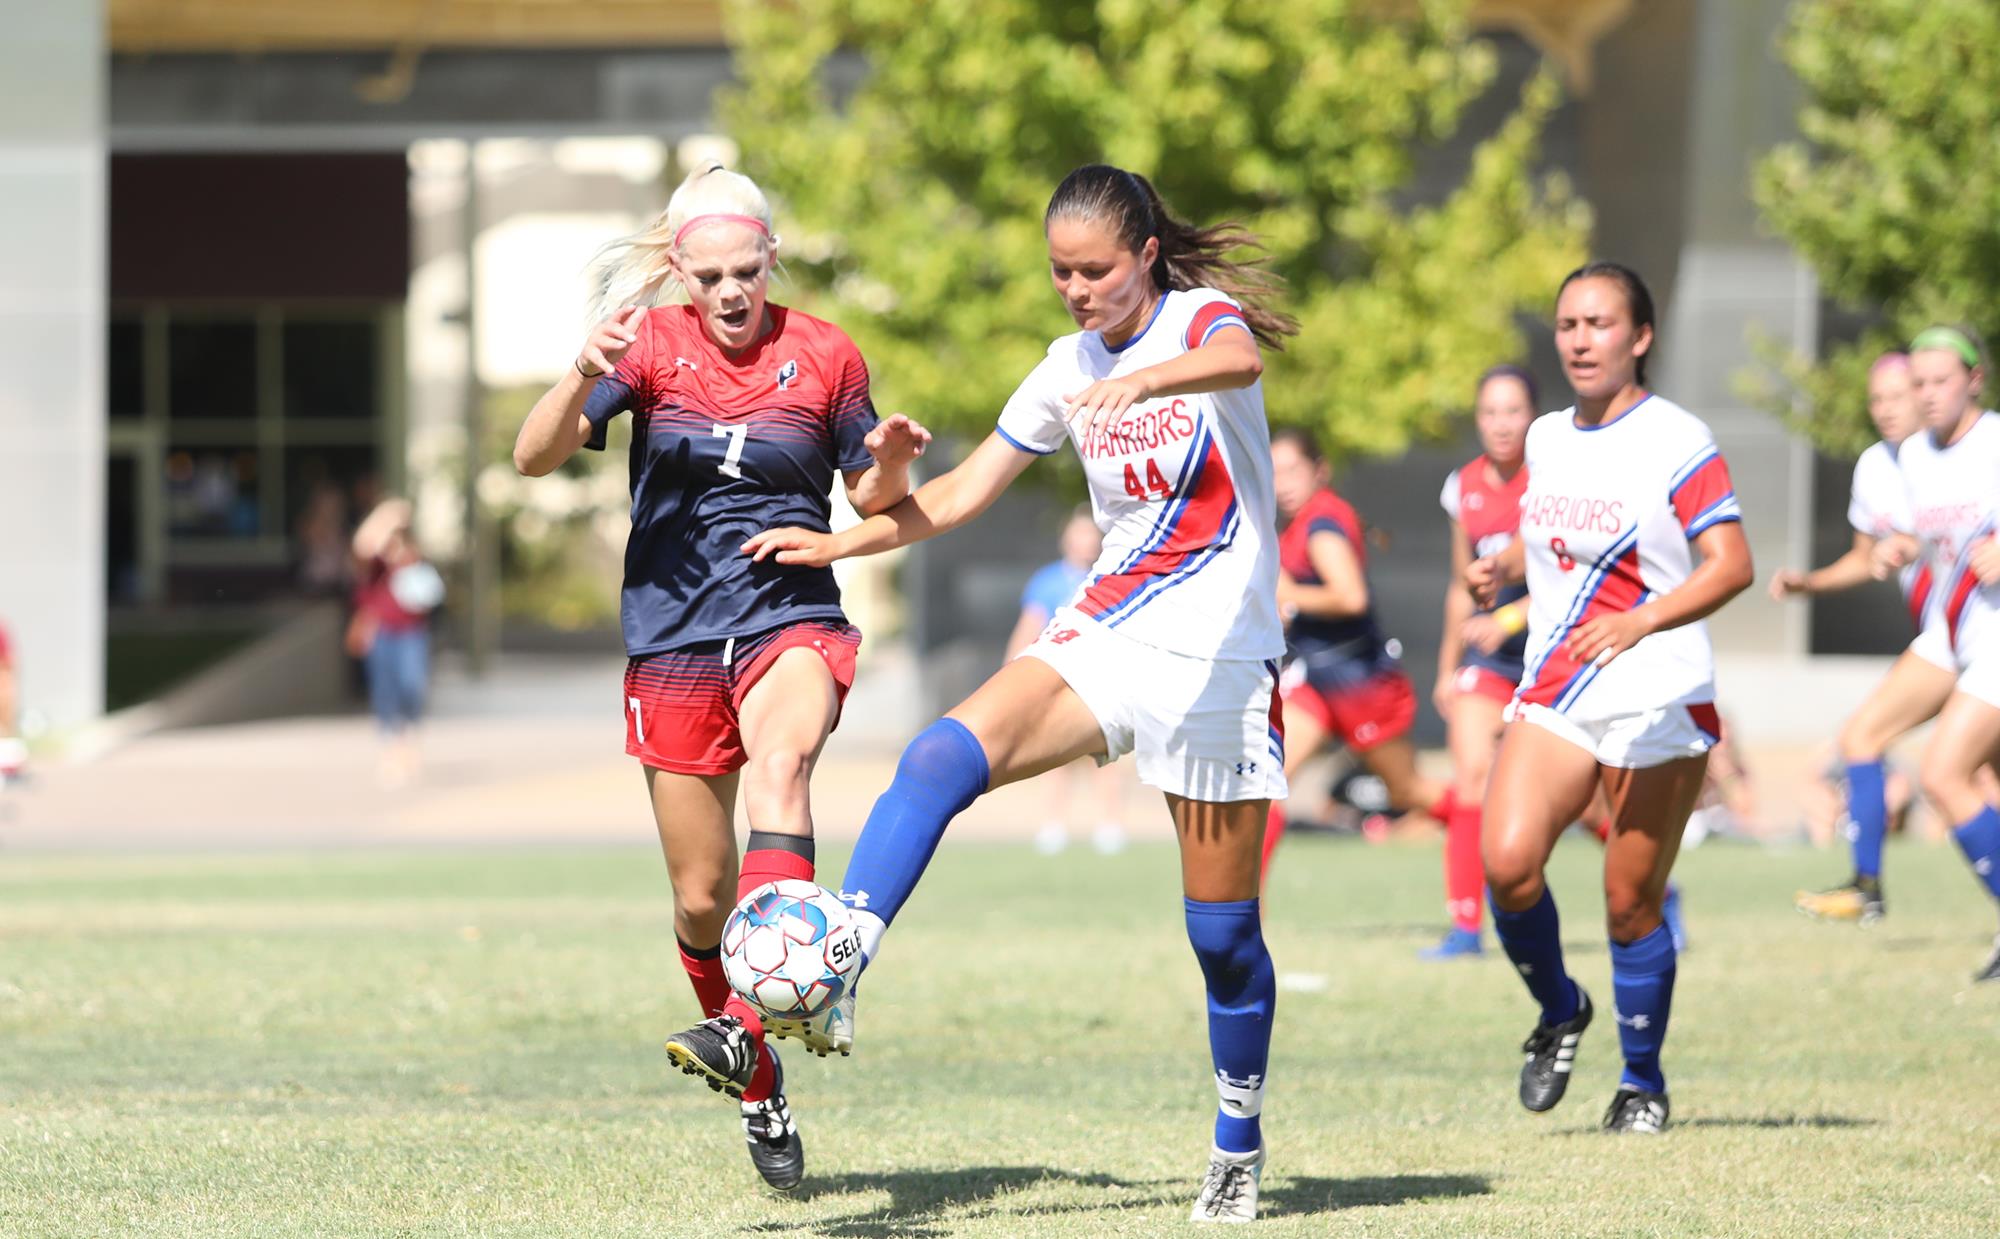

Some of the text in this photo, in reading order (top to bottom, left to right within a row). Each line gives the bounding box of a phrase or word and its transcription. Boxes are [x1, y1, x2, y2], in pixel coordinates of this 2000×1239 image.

[712, 423, 748, 479] 7
[1123, 457, 1176, 501] 44
[1520, 494, 1622, 534] ARRIORS
[628, 695, 645, 744] 7
